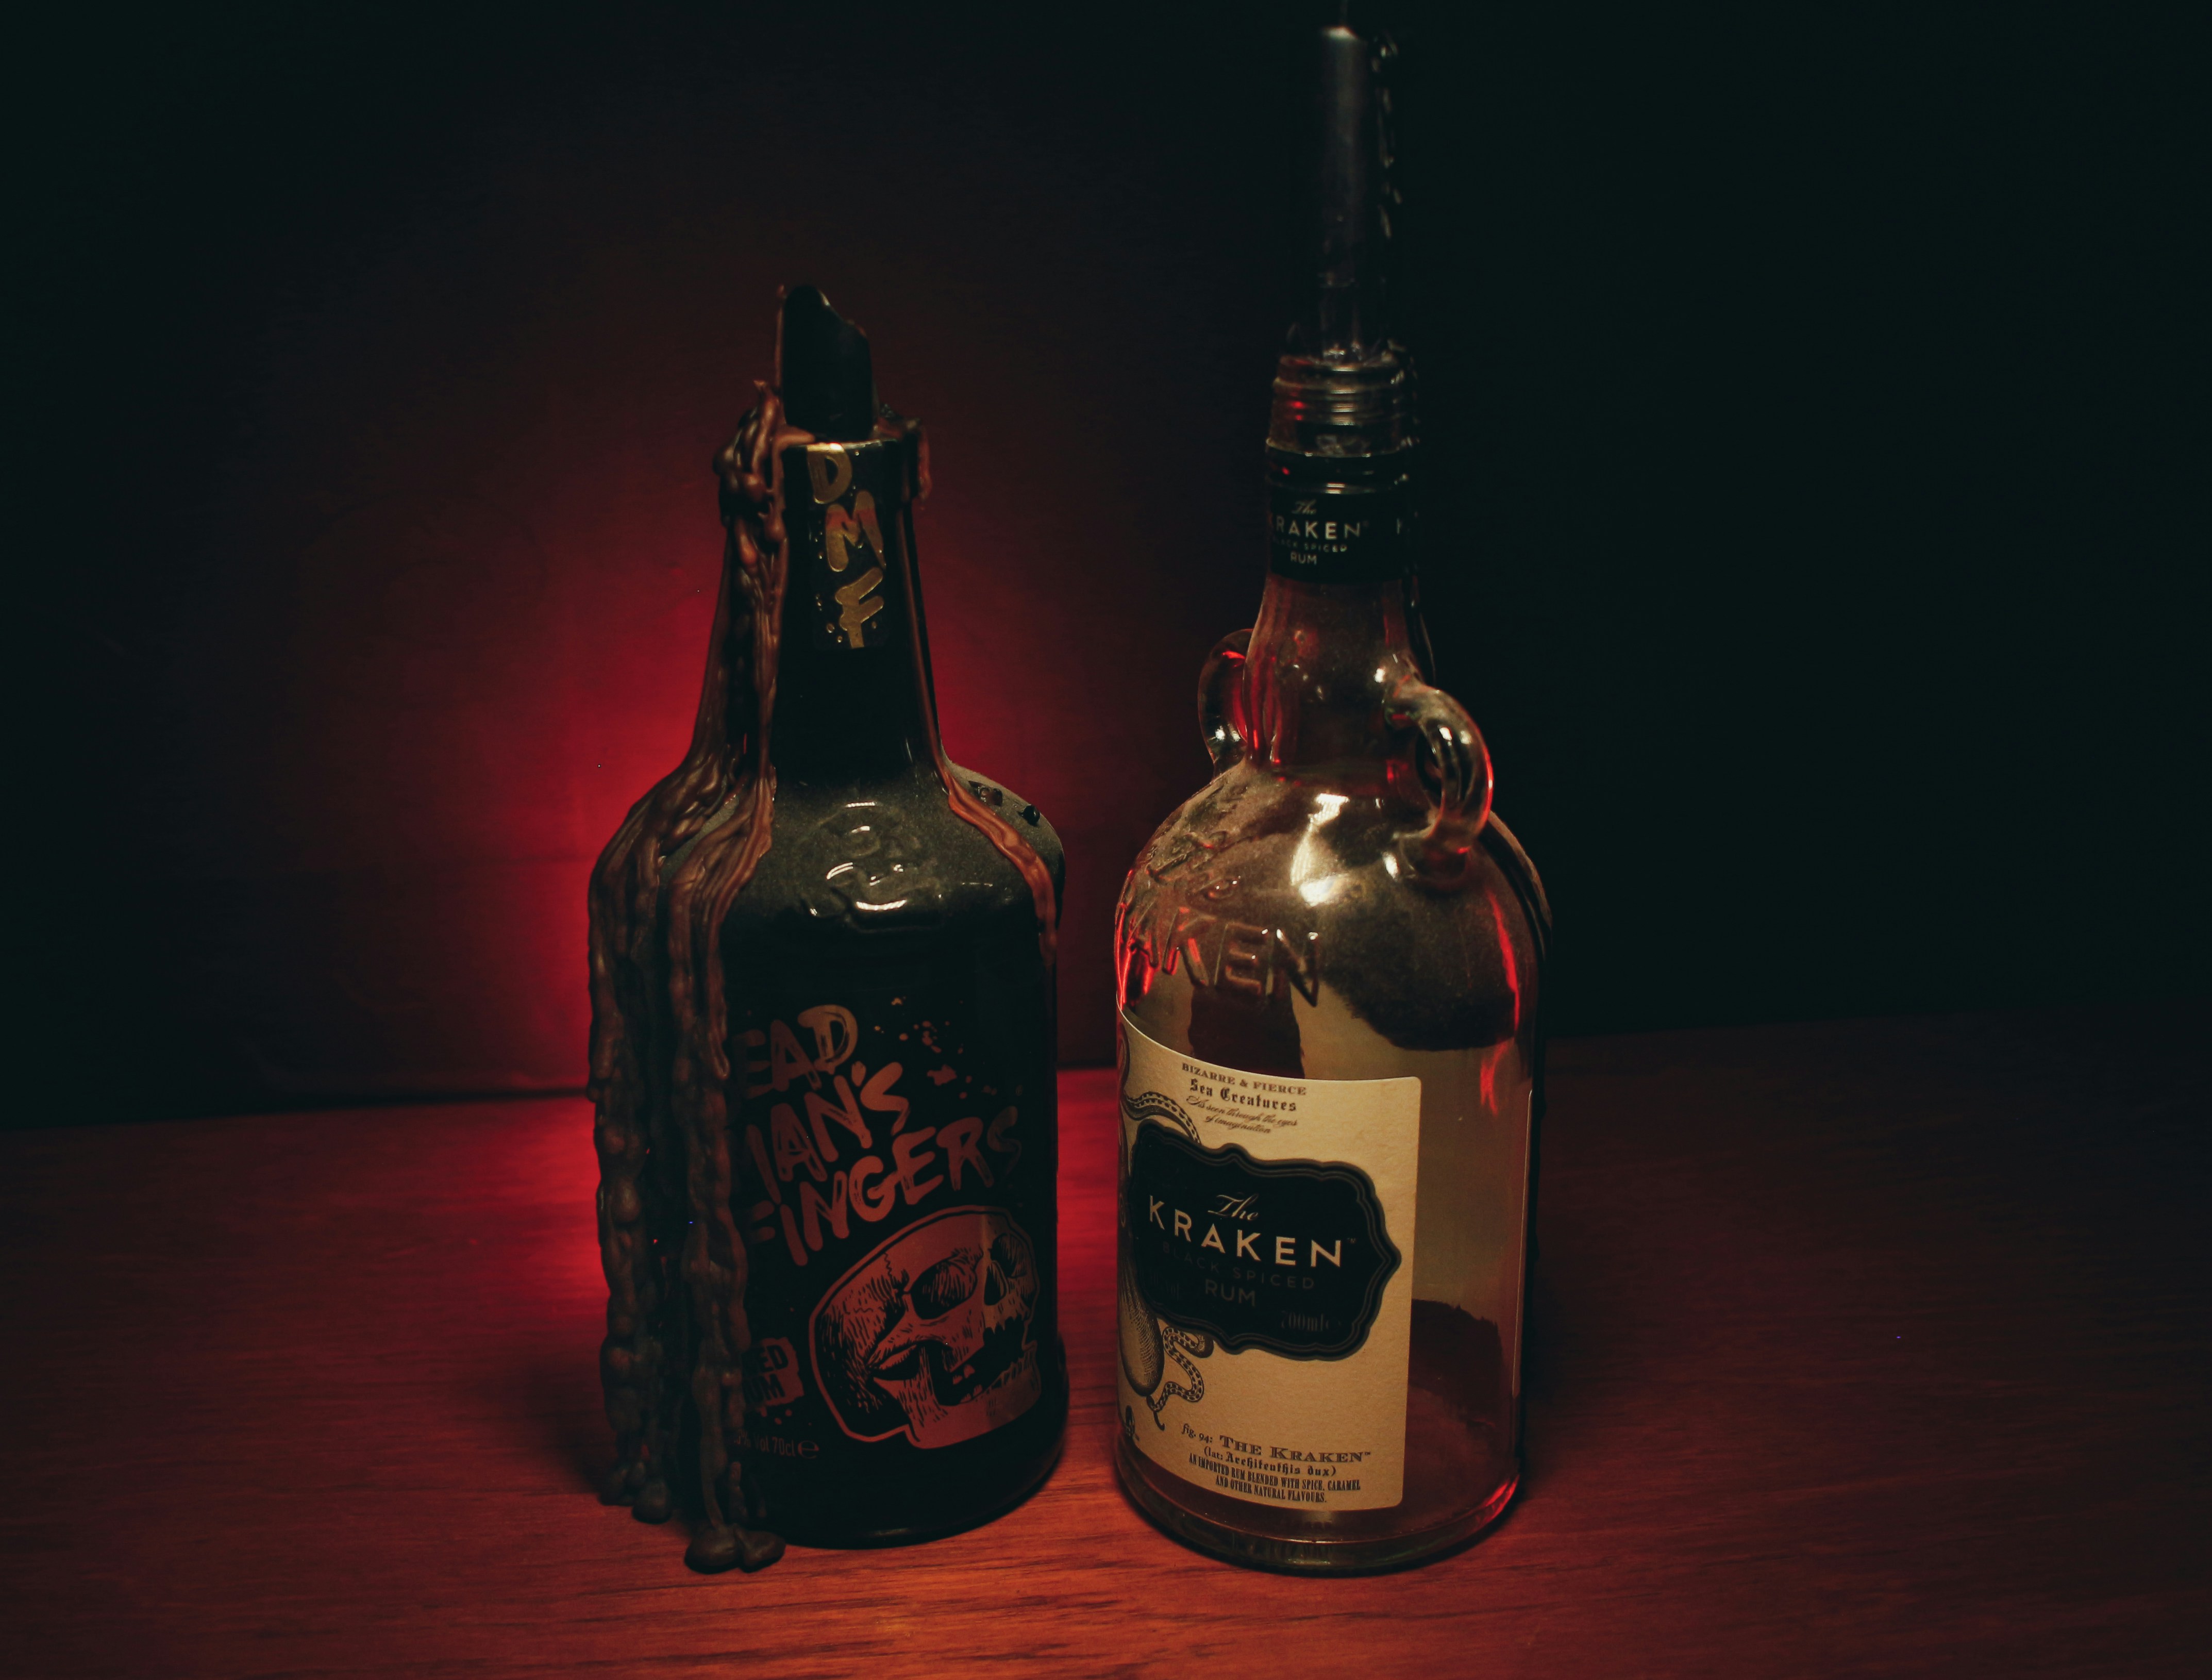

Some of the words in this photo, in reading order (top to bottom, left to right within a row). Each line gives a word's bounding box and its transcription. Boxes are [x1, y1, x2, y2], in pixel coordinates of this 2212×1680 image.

[1292, 498, 1317, 515] The
[1276, 515, 1361, 540] RAKEN
[1290, 551, 1318, 565] RUM
[734, 1004, 859, 1099] EAD
[1182, 1063, 1235, 1085] BIZARRE
[1239, 1079, 1248, 1087] &
[1253, 1082, 1306, 1095] FIERCE
[1190, 1078, 1213, 1097] Sea
[1220, 1087, 1297, 1111] Creatures
[1208, 1192, 1260, 1221] The
[1149, 1194, 1342, 1268] KRAKEN
[1163, 1241, 1220, 1274] BLACK
[1232, 1267, 1315, 1290] SPICED
[1205, 1278, 1256, 1307] RUM
[1181, 1423, 1196, 1438] fig.
[1199, 1433, 1213, 1443] 94:
[1219, 1435, 1262, 1455] THE
[1189, 1453, 1197, 1465] AN
[1198, 1456, 1229, 1476] IMPORTED
[1231, 1467, 1245, 1480] RUM
[1248, 1471, 1278, 1486] BLENDED
[1281, 1477, 1300, 1489] WITH
[1328, 1479, 1361, 1491] CARAMEL
[1215, 1474, 1228, 1488] AND
[1230, 1479, 1252, 1494] OTHER
[1253, 1484, 1285, 1500] NATURAL
